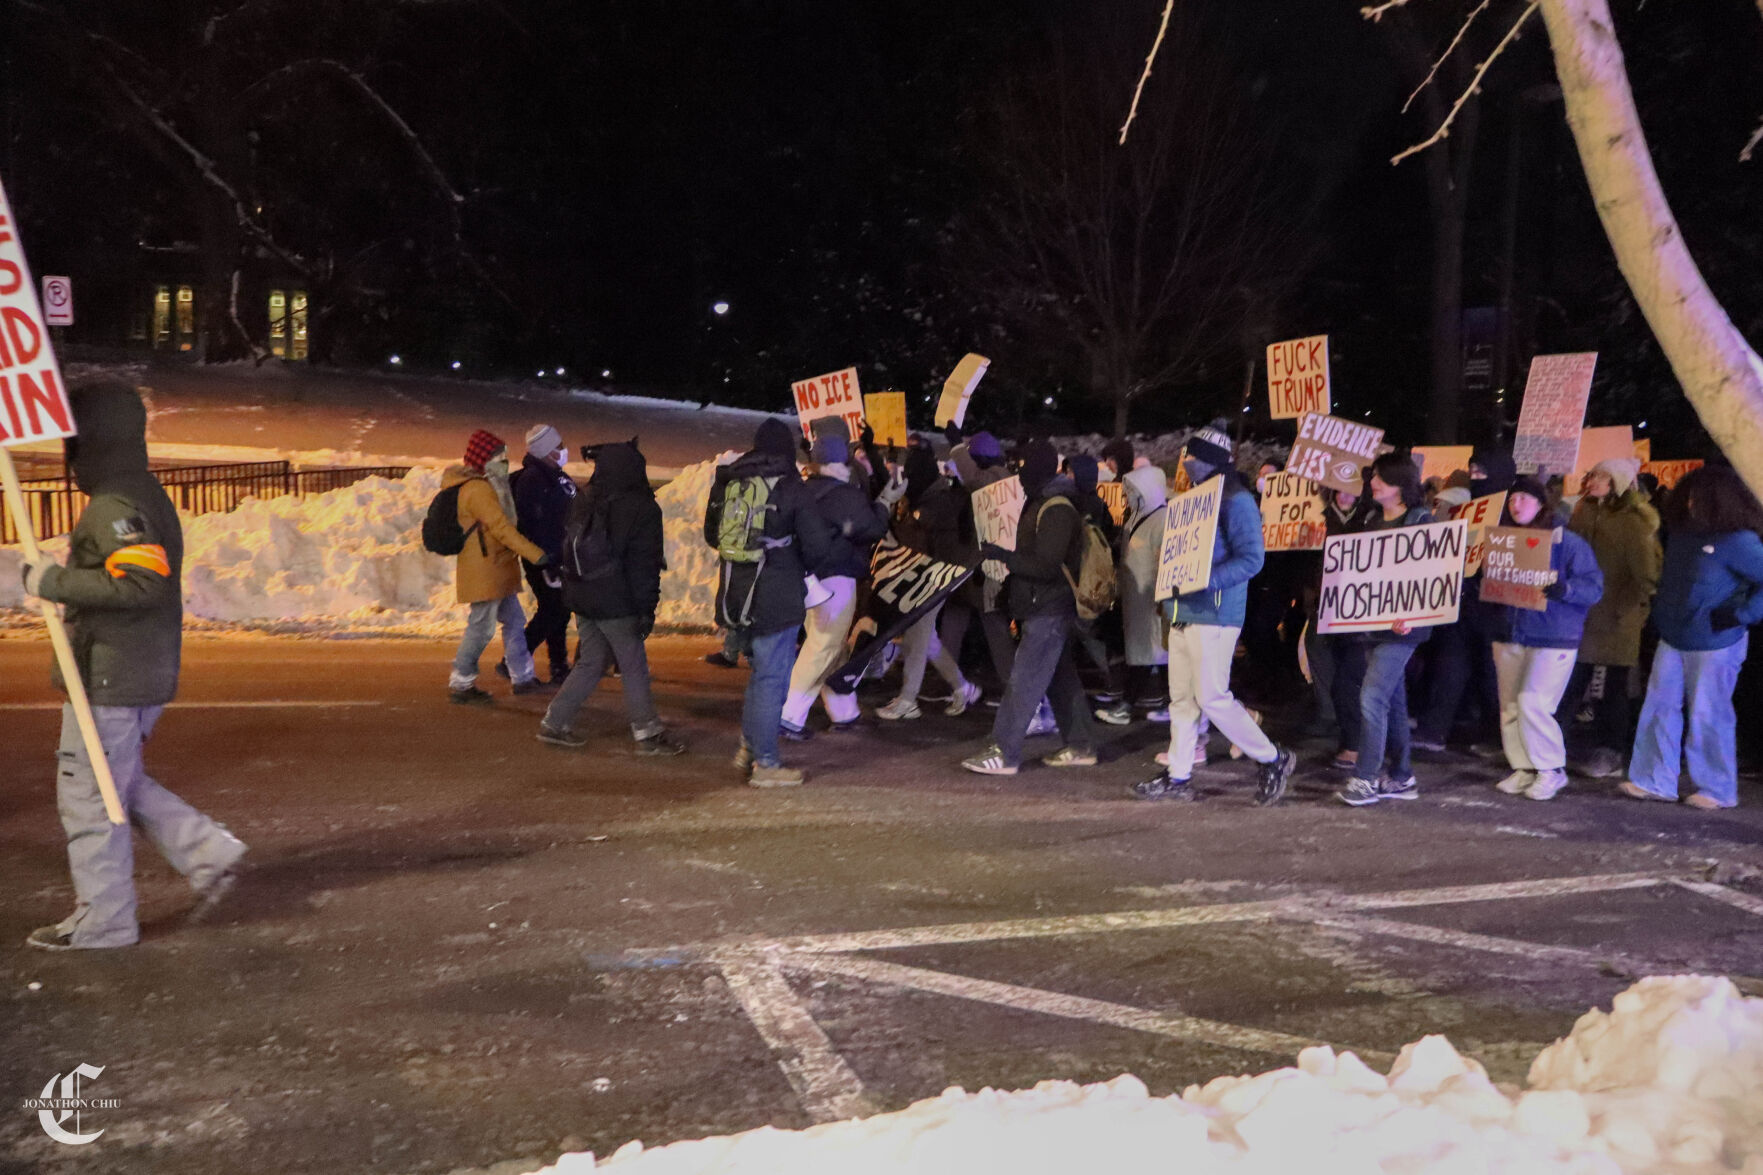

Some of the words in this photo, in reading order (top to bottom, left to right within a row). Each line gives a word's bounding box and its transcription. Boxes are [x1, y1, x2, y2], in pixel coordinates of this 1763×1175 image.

[1272, 341, 1321, 376] FUCK
[797, 383, 819, 411] NO
[821, 372, 852, 406] ICE
[1272, 374, 1325, 414] TRUMP
[1300, 413, 1381, 460] EVIDENCE
[1287, 444, 1332, 481] LIES
[976, 478, 1018, 512] ADMIN
[1265, 472, 1320, 499] JUSTIC
[1167, 501, 1181, 532] NO
[1181, 491, 1216, 527] HUMAN
[1162, 531, 1188, 566] BEING
[1188, 526, 1200, 552] IS
[1262, 521, 1300, 548] RENEE
[1324, 533, 1393, 574] SHUT
[1394, 525, 1463, 565] DOWN
[1489, 533, 1516, 549] WE
[1488, 550, 1515, 568] OUR
[1319, 572, 1460, 620] MOSHANNON
